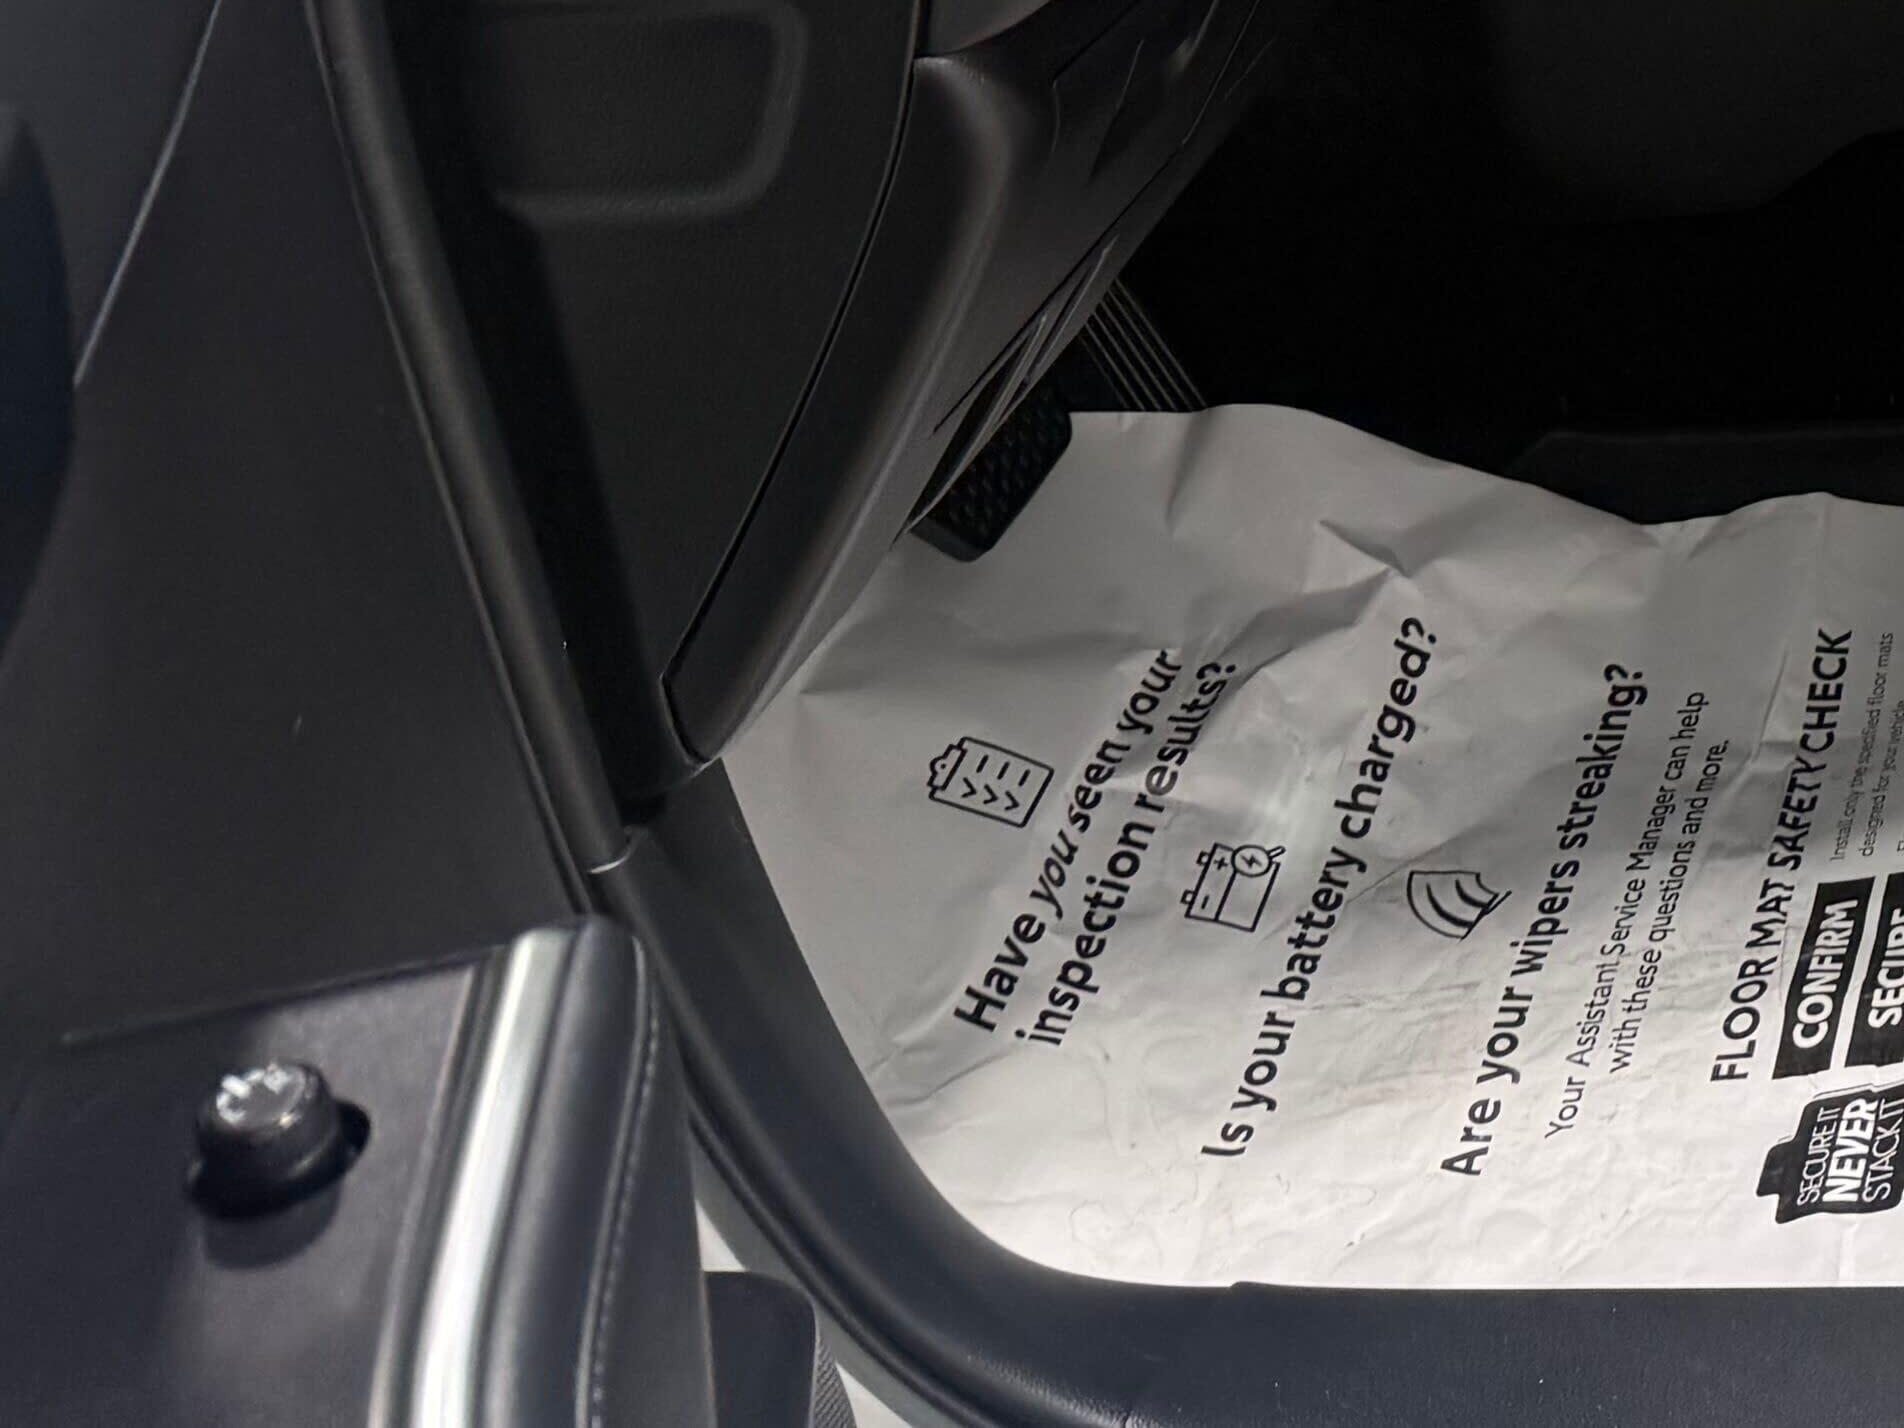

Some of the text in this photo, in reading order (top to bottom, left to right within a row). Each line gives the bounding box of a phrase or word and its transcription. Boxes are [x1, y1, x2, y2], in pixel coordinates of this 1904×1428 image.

[1664, 746, 1690, 781] can
[1669, 692, 1709, 741] help
[1829, 818, 1853, 861] Install
[1866, 672, 1886, 705] floor
[1877, 632, 1894, 667] mats
[953, 649, 1182, 1032] Have you seen your
[1015, 661, 1237, 1046] inspection results?
[1625, 785, 1676, 871] Manager
[1710, 628, 1852, 1082] FLOOR MAT SAFETY CHECK
[1859, 795, 1885, 857] designed
[1201, 616, 1436, 1157] Is your battery charged?
[1440, 663, 1649, 1176] Are your wipers streaking?
[1600, 878, 1646, 957] Service
[1609, 740, 1729, 1074] with these questions and more.
[1792, 900, 1859, 1049] CONFIRM
[1545, 1077, 1586, 1140] Your
[1797, 1107, 1841, 1206] SECURE IT
[1822, 1098, 1879, 1202] NEVER
[1862, 1118, 1903, 1203] STACK
